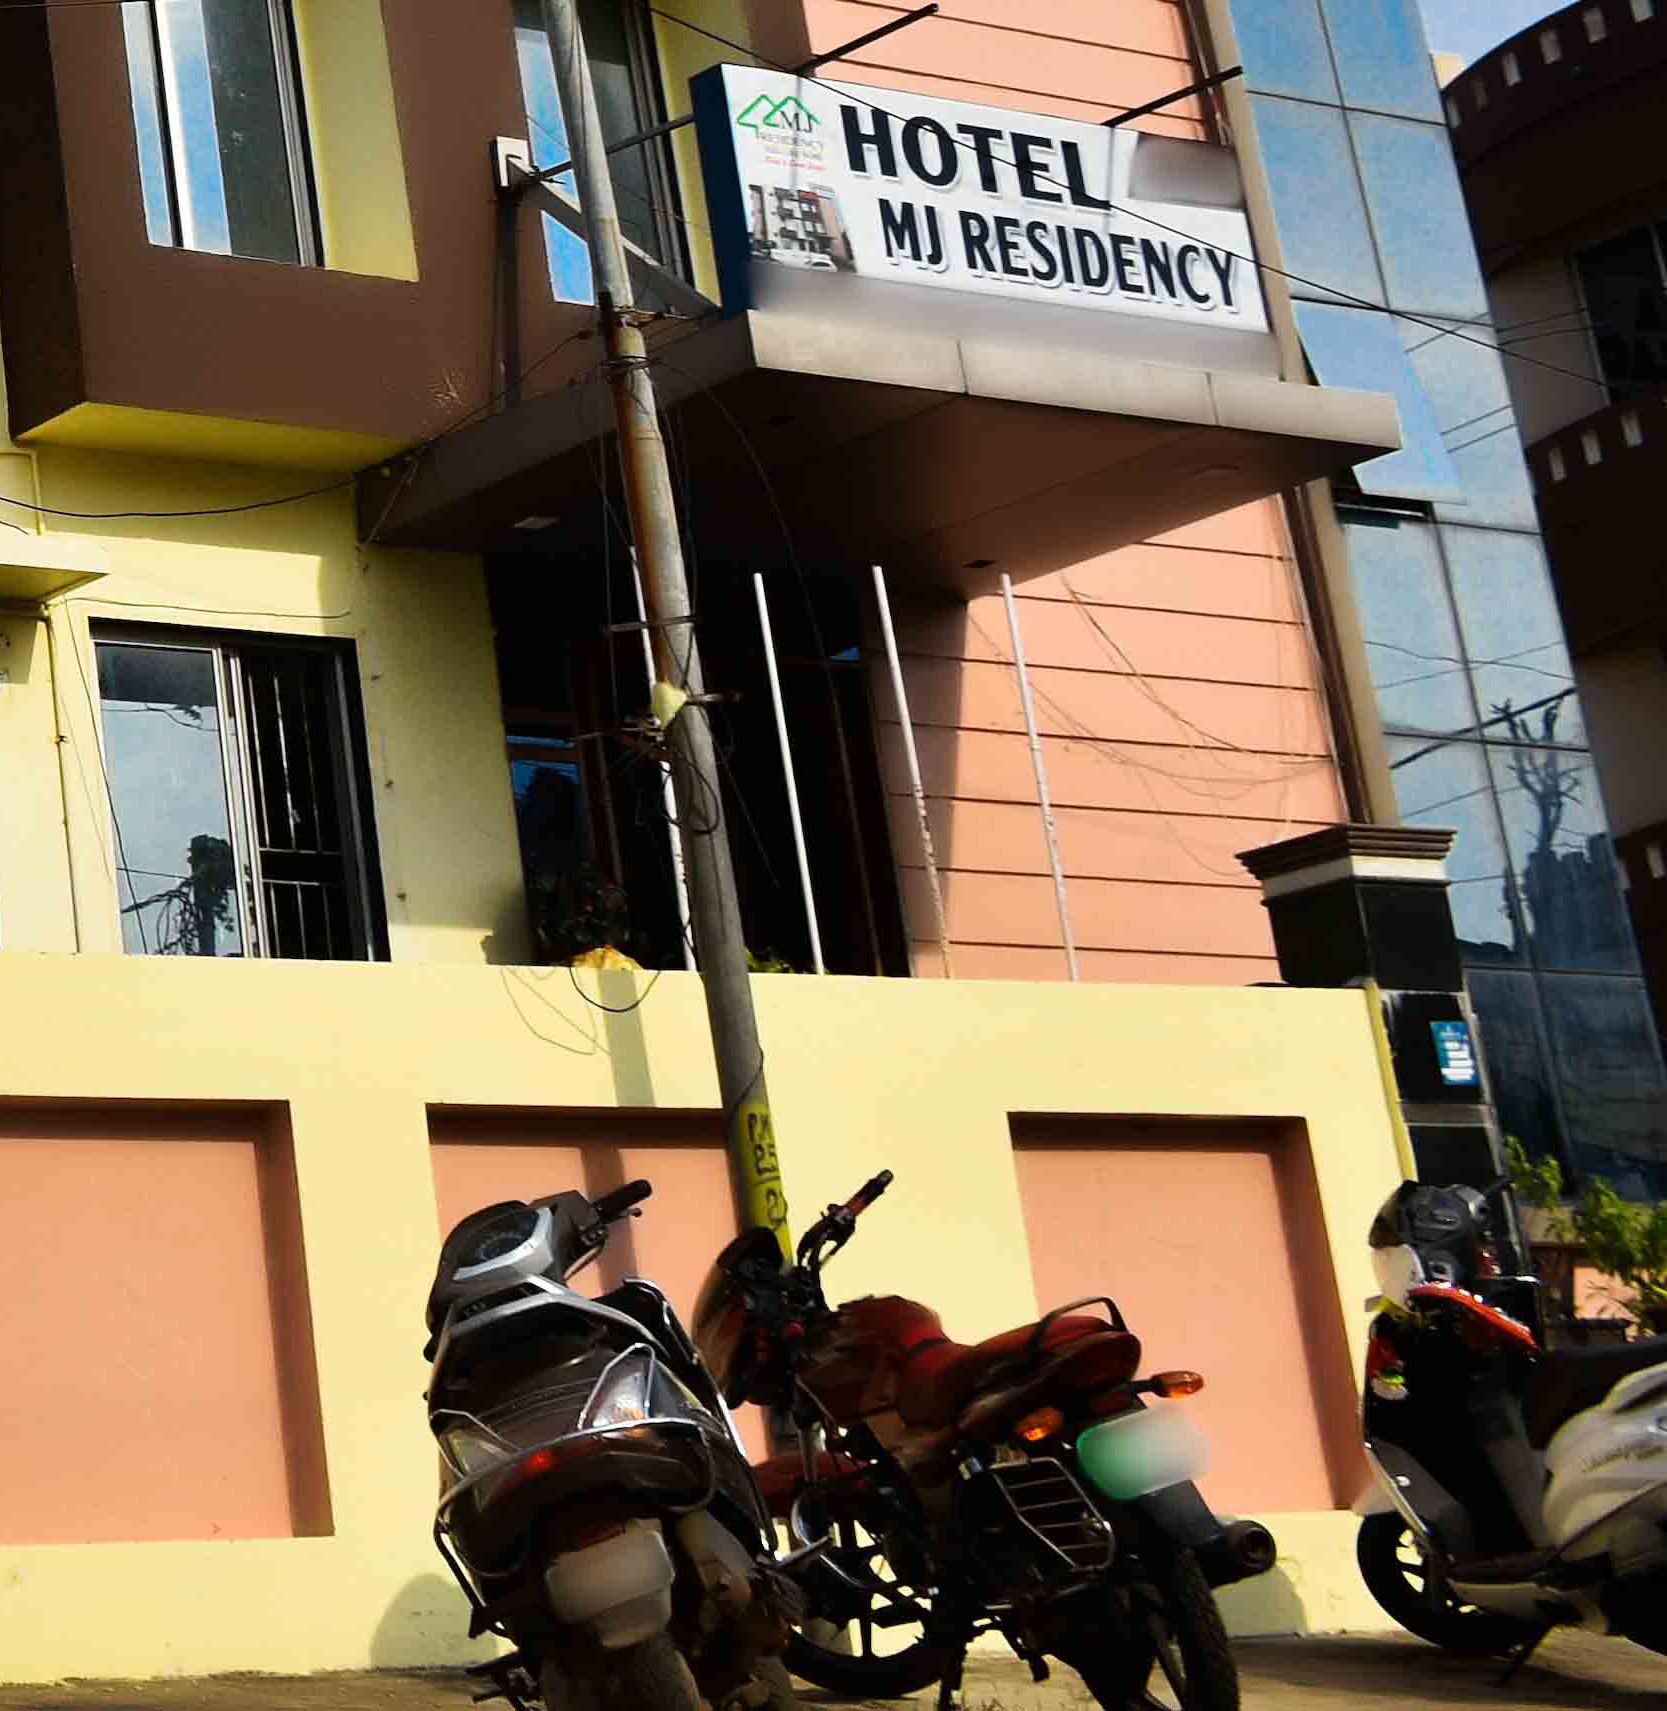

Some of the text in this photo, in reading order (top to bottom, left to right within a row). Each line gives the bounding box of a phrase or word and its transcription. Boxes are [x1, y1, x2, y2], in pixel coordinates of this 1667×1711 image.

[839, 104, 1111, 212] HOTEL
[878, 197, 1237, 309] MJ RESIDENCY
